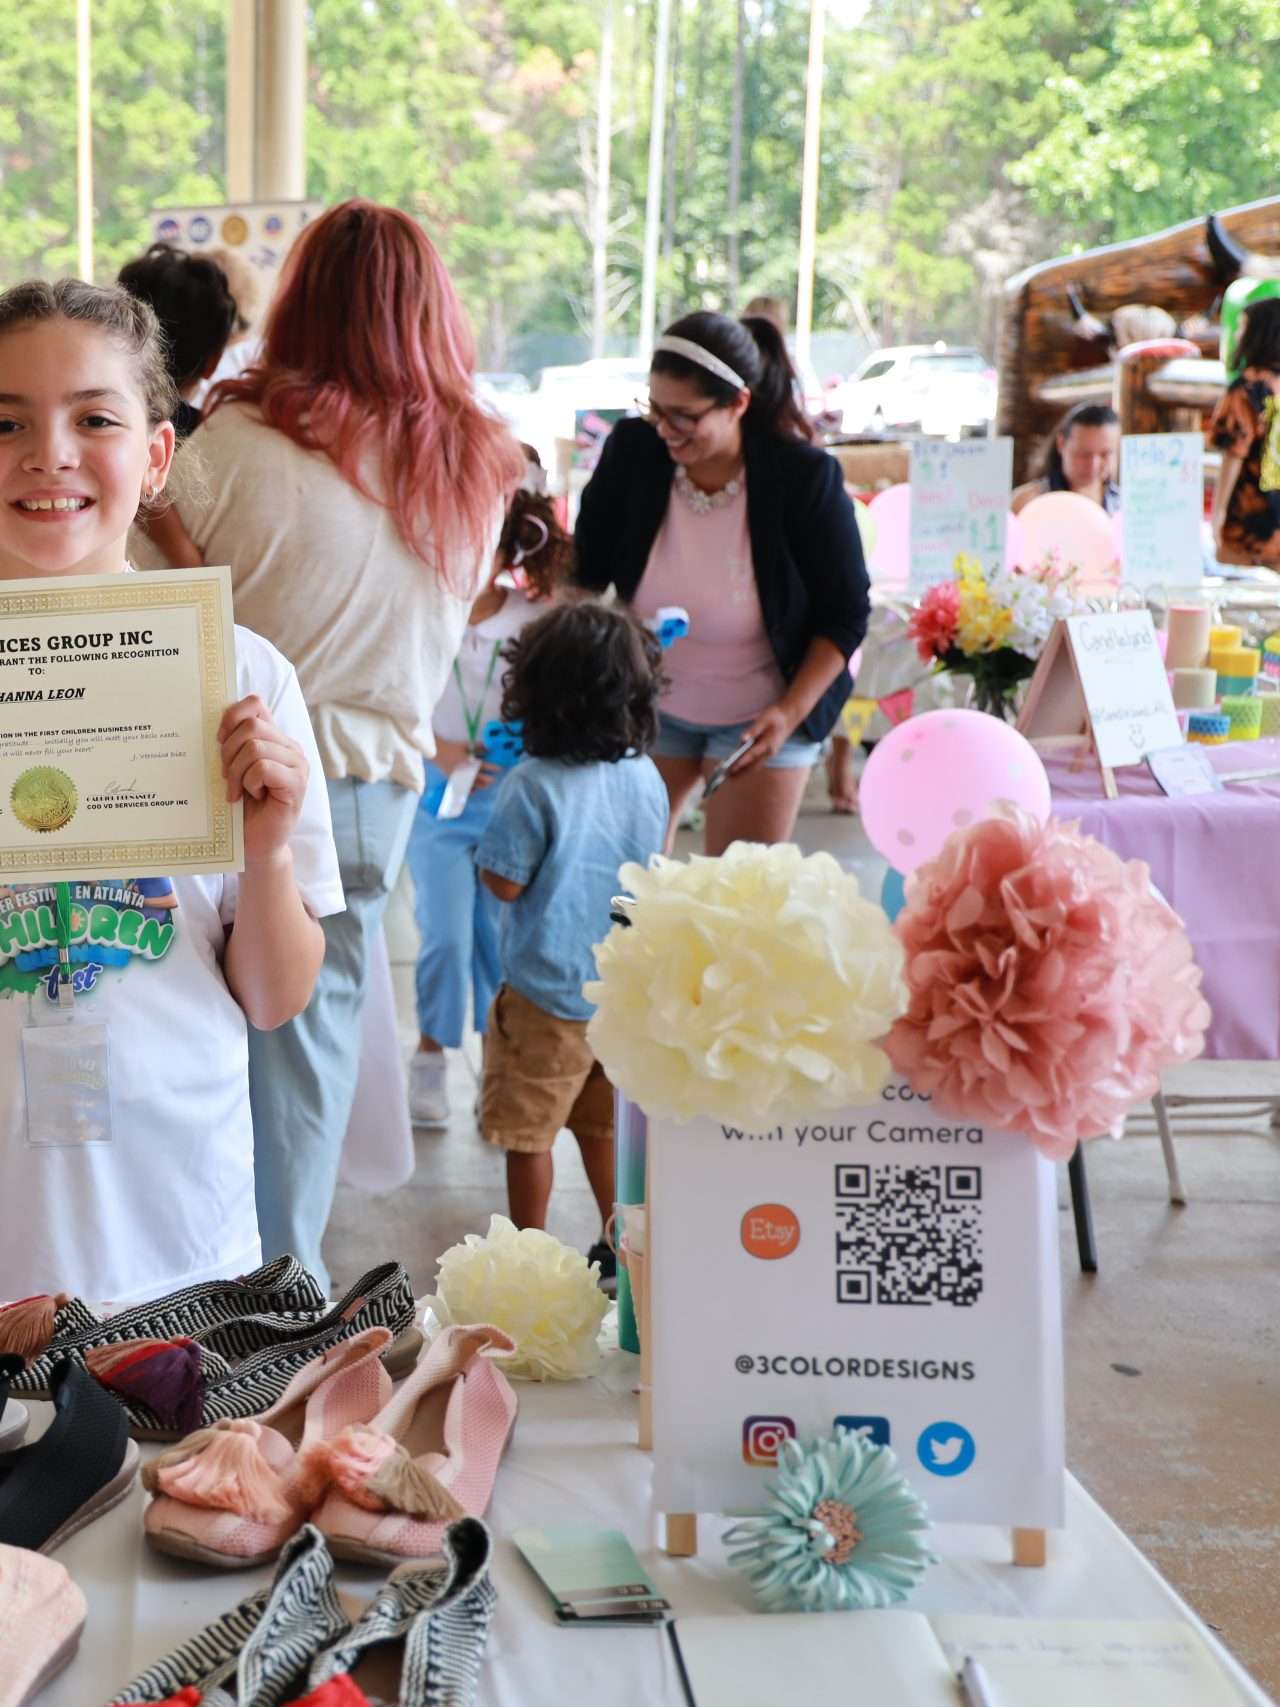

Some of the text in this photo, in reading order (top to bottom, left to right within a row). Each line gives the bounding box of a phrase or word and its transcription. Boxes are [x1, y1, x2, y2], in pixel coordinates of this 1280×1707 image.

[47, 633, 114, 651] GROUP
[119, 630, 153, 646] INC
[27, 655, 48, 665] THE
[50, 652, 109, 664] FOLLOWING
[111, 648, 180, 660] RECOGNITION
[27, 667, 46, 676] TO:
[47, 687, 86, 701] LEON
[61, 728, 97, 736] CHILDREN
[97, 725, 133, 733] BUSINESS
[115, 801, 149, 809] SERVICES
[75, 885, 91, 900] EN
[93, 885, 146, 909] ATLANTA
[44, 962, 104, 1001] fst
[794, 1124, 857, 1147] your
[866, 1120, 985, 1144] Camera
[749, 1217, 795, 1247] Etsy
[733, 1354, 977, 1381] @3COLORDESIGNS
